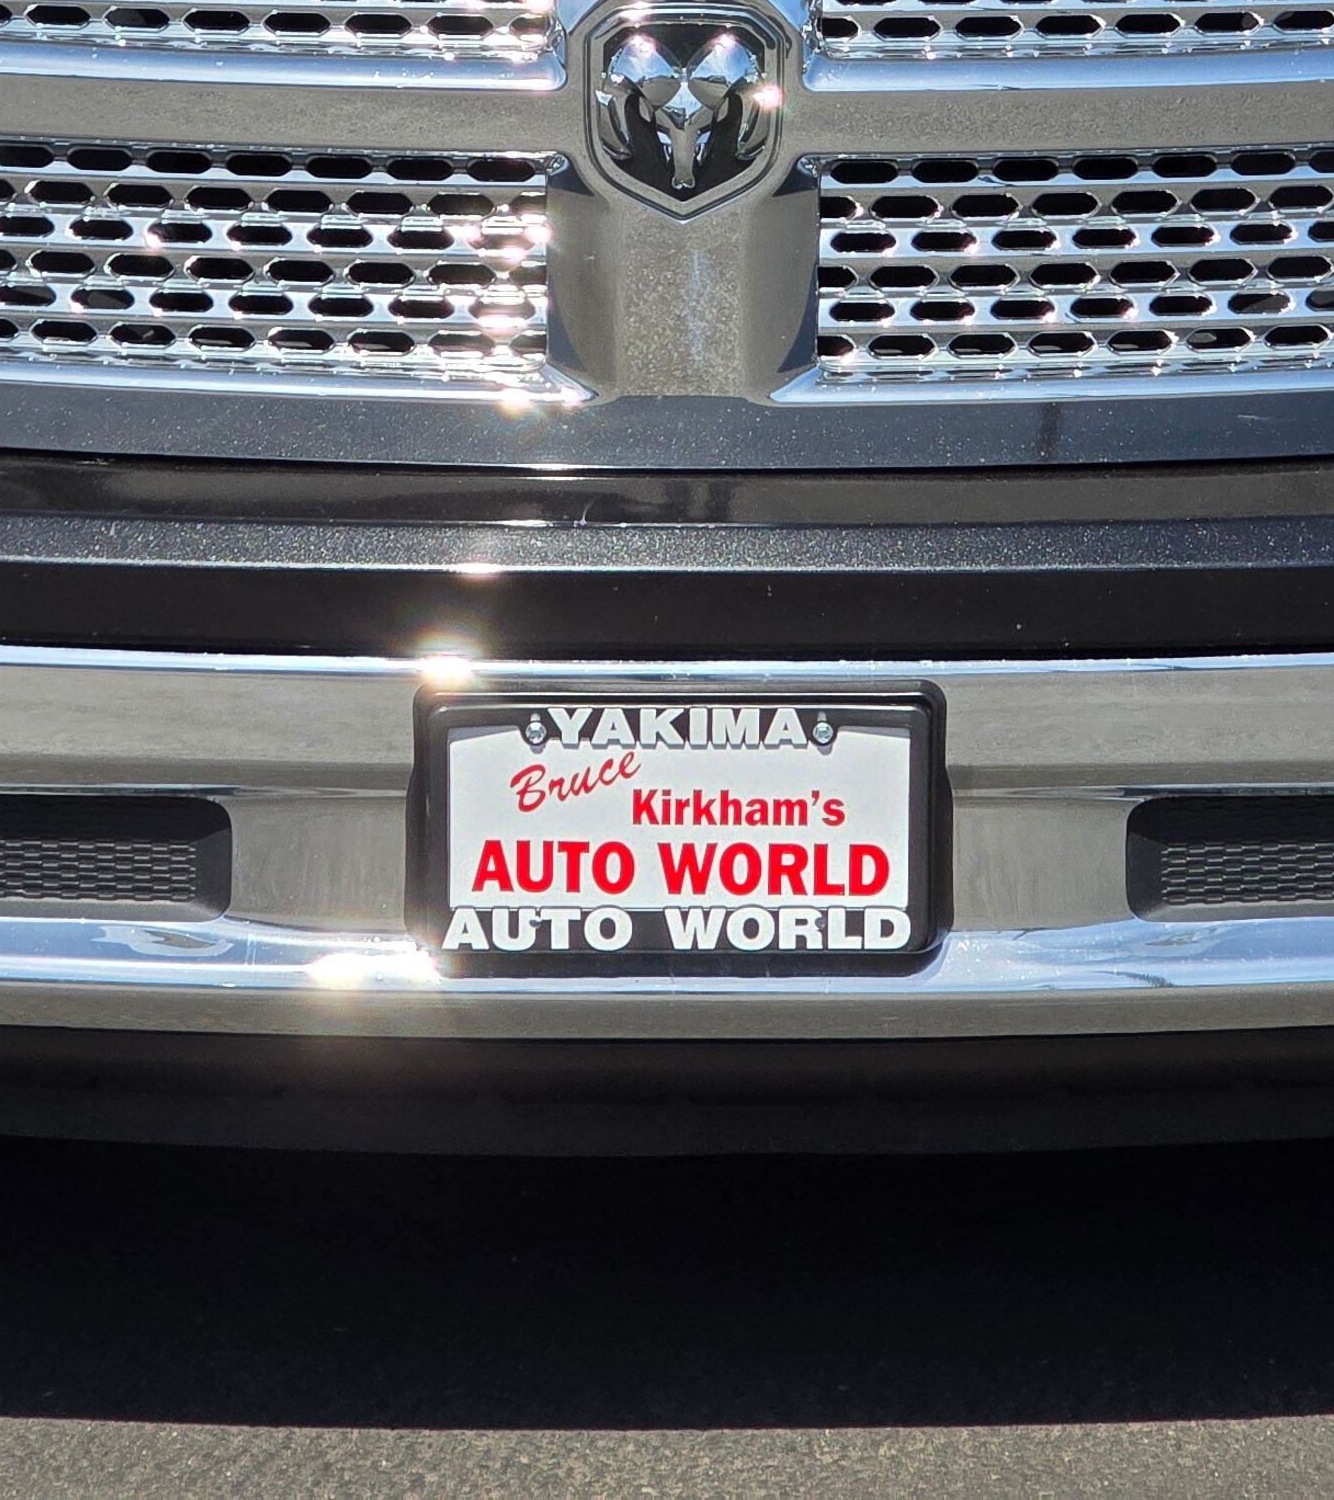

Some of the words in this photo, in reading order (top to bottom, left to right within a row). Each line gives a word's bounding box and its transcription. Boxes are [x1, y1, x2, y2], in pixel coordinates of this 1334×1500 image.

[547, 706, 809, 746] YAKIMA
[510, 751, 643, 813] Bruce
[632, 788, 846, 827] Kirkham's
[472, 840, 635, 895] AUTO
[657, 842, 890, 897] WORLD
[442, 906, 633, 952] AUTO
[663, 907, 912, 952] WORLD
